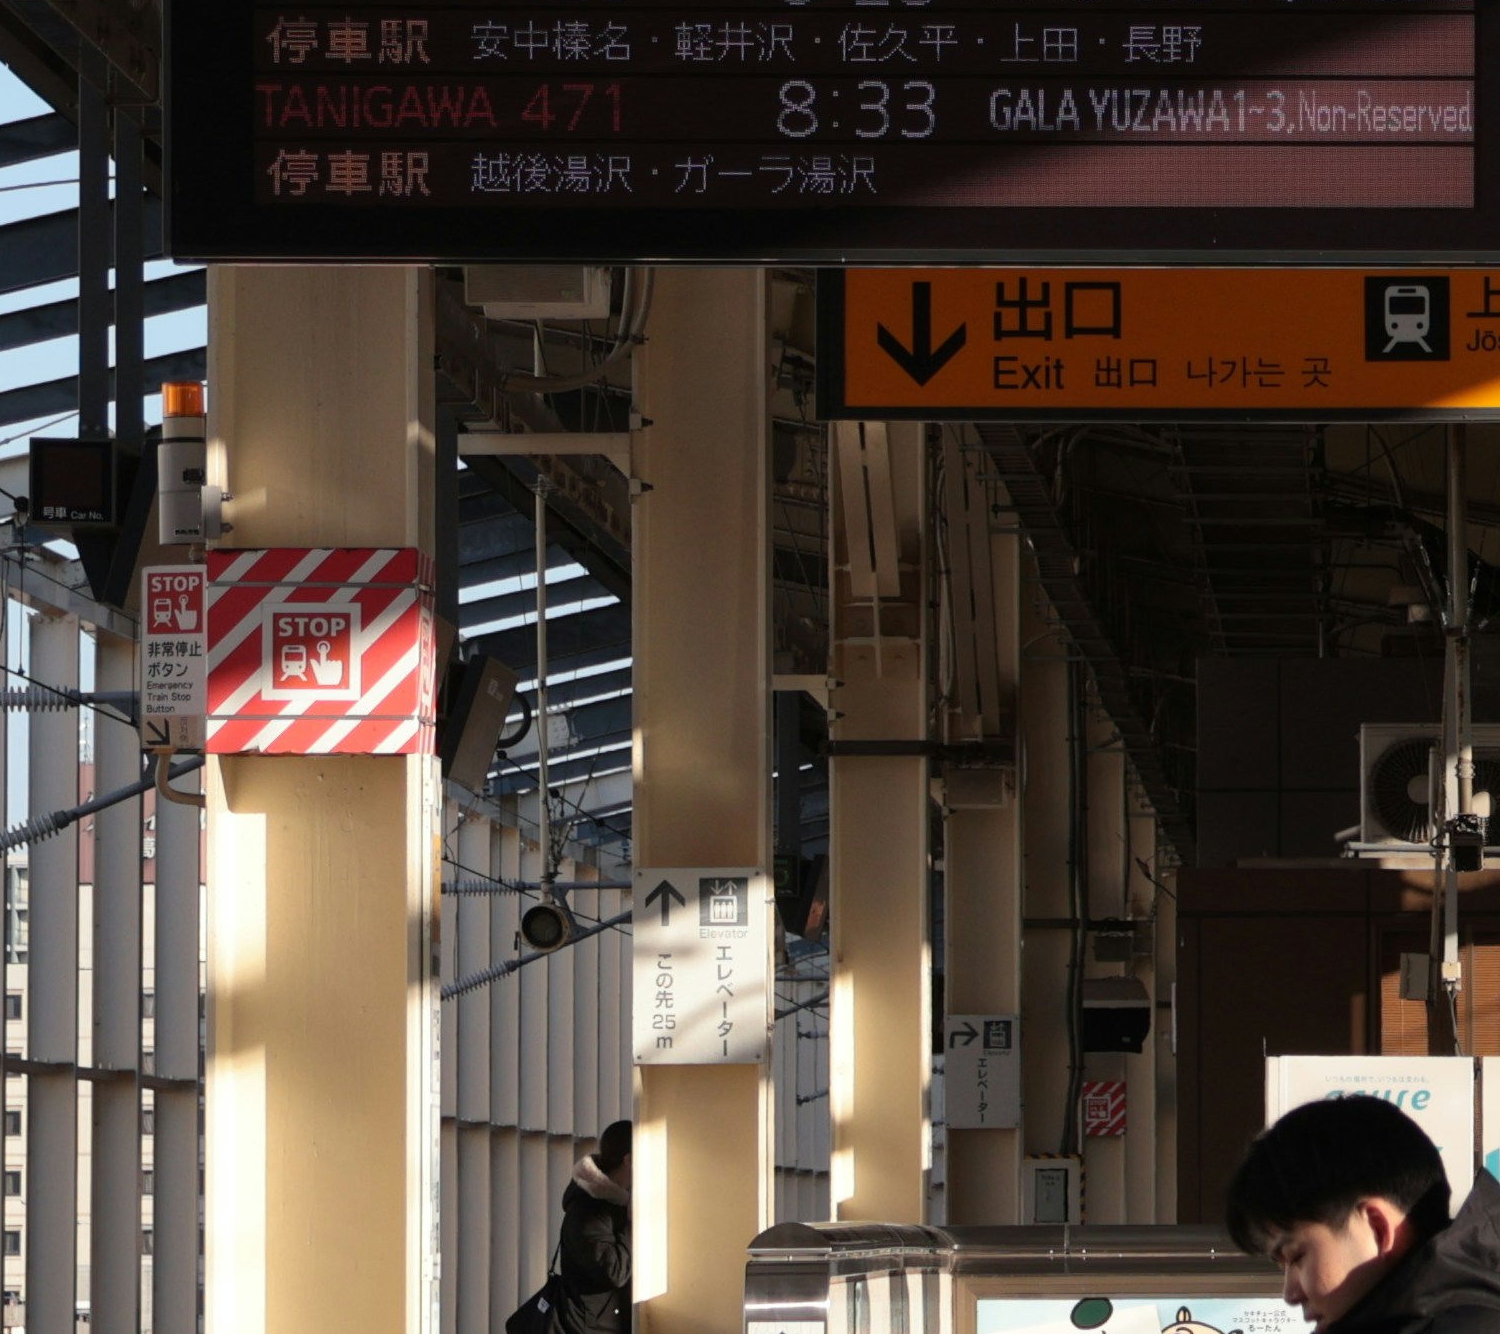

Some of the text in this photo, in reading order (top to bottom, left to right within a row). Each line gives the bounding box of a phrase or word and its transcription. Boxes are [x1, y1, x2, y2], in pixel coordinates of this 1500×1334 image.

[266, 17, 431, 64] 停車駅
[255, 84, 498, 129] TANIGAWA
[521, 84, 622, 131] 471
[776, 80, 936, 138] 8:33
[988, 89, 1080, 132] GALA
[1087, 89, 1230, 132] YUZAWA
[266, 149, 431, 197] 停車駅
[993, 276, 1123, 341] 出口
[993, 357, 1065, 390] Exit
[1095, 358, 1158, 389] 出口
[1185, 356, 1332, 389] 나가는 곳
[43, 506, 67, 520] 号車
[70, 510, 105, 520] Car No.
[151, 576, 200, 592] STOP
[278, 617, 346, 637] STOP
[147, 641, 202, 658] 非常停止
[147, 662, 188, 677] ボタン
[147, 681, 193, 692] Emergency
[147, 692, 191, 703] Train Stop
[146, 705, 175, 713] Button
[700, 928, 748, 939] Elevator
[715, 945, 734, 1057] エレベーター
[977, 1058, 988, 1123] エレベーター
[1248, 1324, 1282, 1332] るーたん
